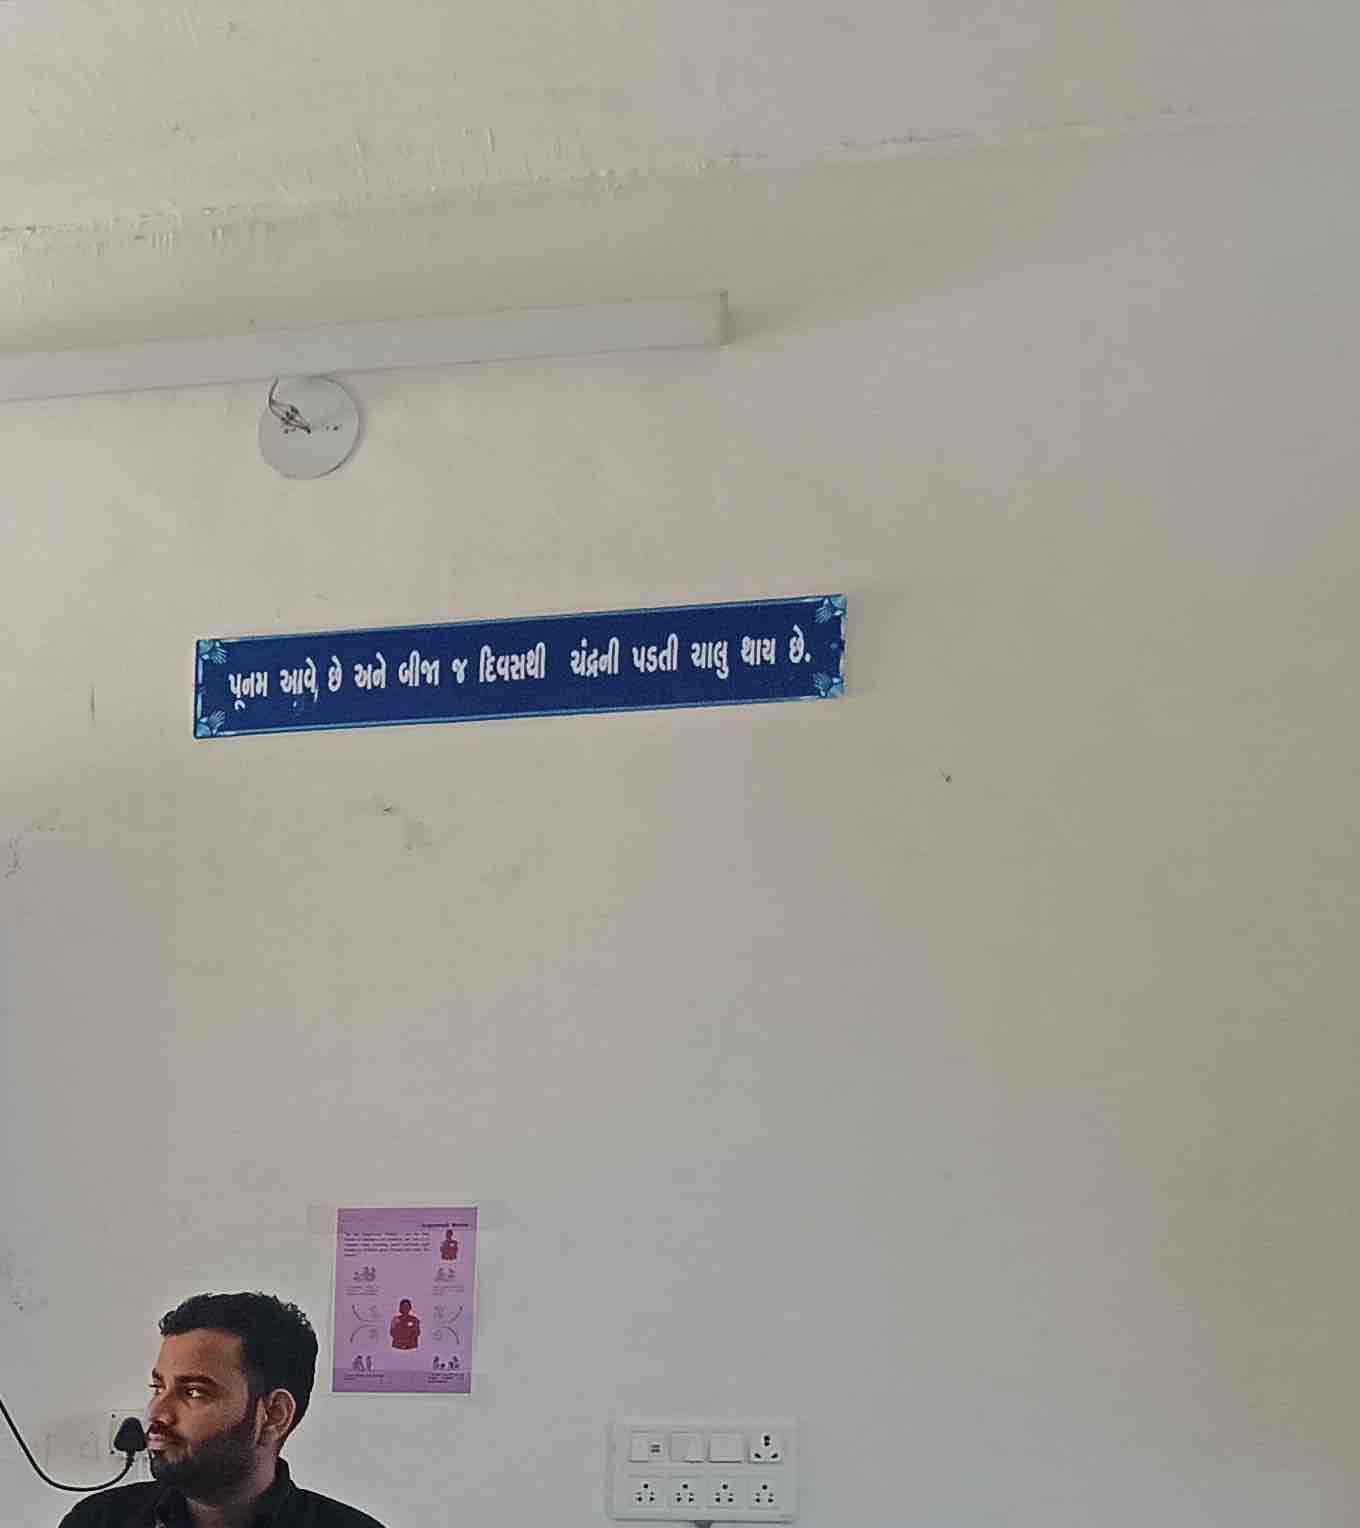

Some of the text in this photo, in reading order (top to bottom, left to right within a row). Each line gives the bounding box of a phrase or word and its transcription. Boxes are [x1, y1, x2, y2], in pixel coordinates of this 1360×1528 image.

[228, 670, 269, 710] પૂનમ
[327, 657, 343, 692] છે
[354, 653, 387, 690] અને
[398, 650, 440, 688] બીજા
[451, 658, 468, 684] જ
[479, 640, 547, 682] દિવસથી
[632, 633, 680, 673] પડતી
[691, 640, 729, 679] ચાલુ
[740, 635, 776, 666] થાય
[789, 624, 812, 664] છે.
